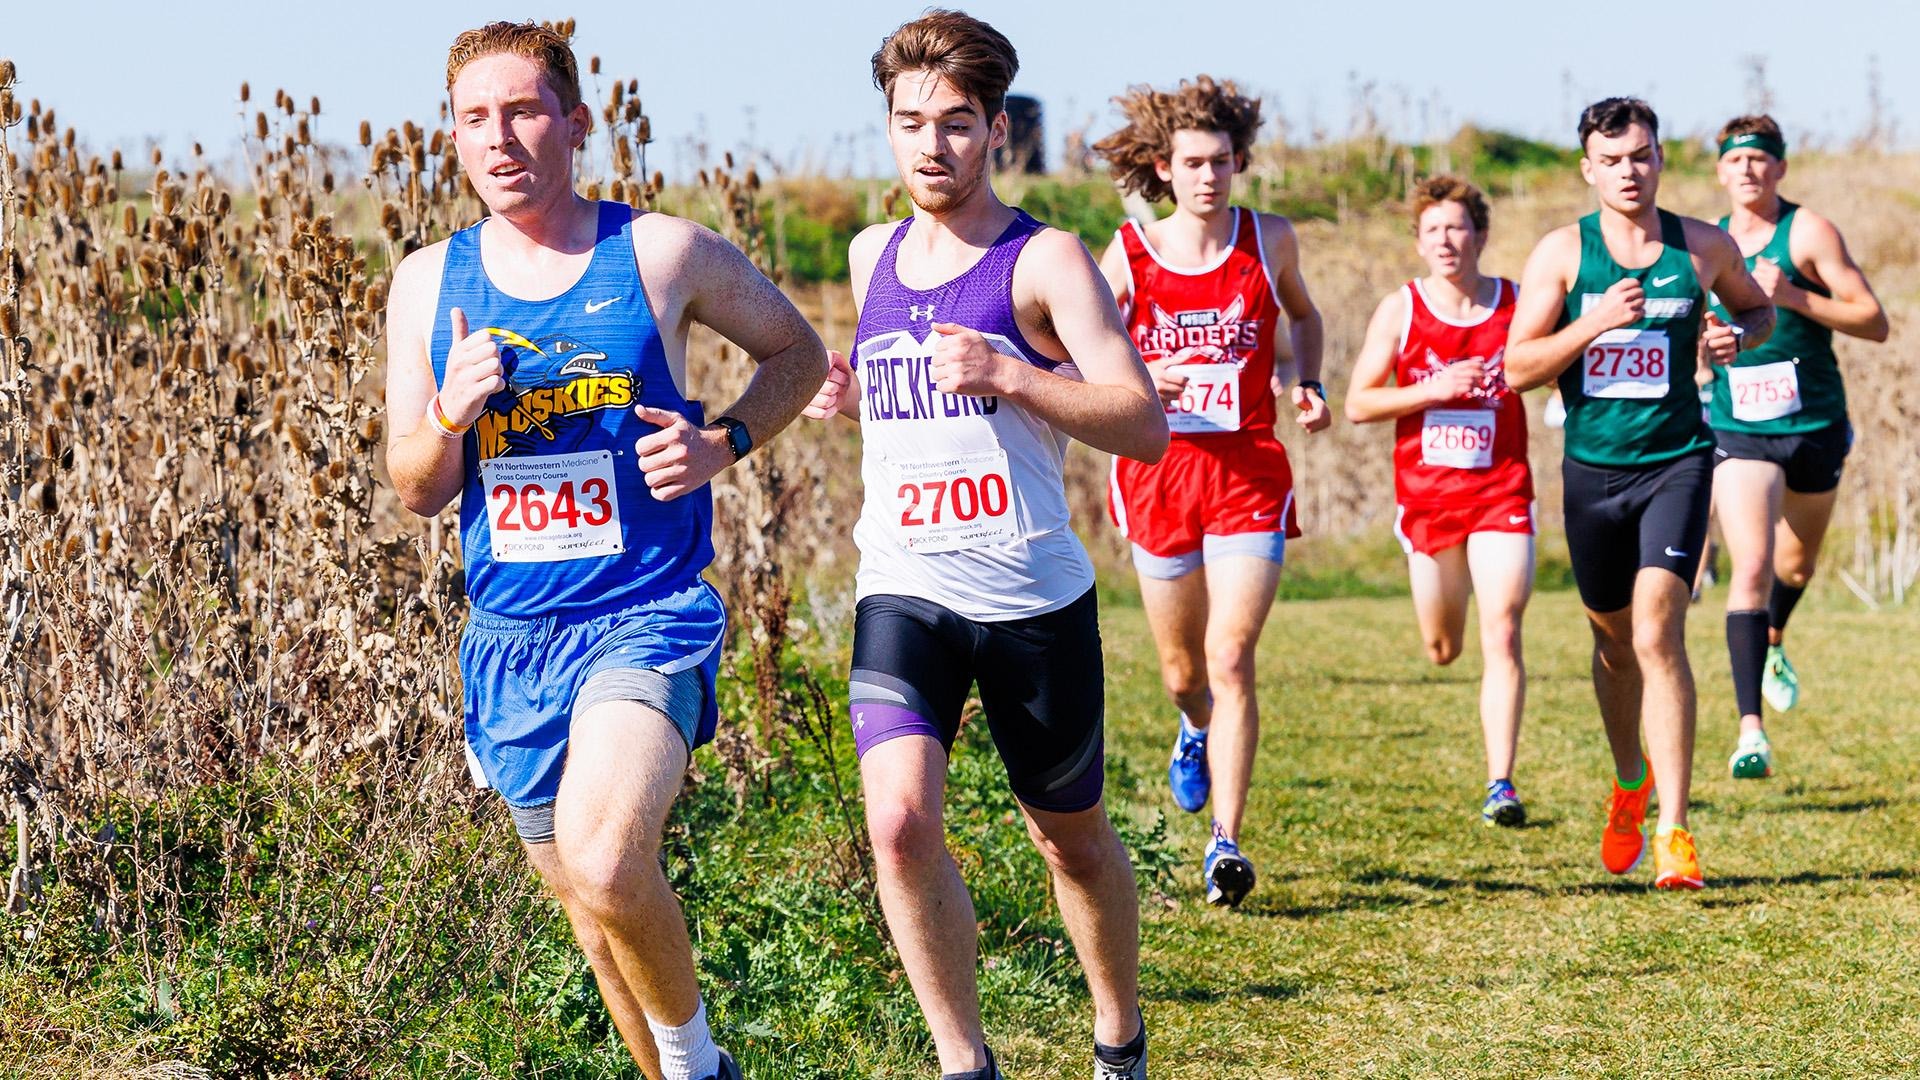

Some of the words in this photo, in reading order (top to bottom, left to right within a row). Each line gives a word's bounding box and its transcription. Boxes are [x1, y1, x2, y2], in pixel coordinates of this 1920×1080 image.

[1139, 323, 1260, 350] RAIDERS
[1588, 346, 1665, 378] 2738
[1165, 382, 1234, 414] 674
[1736, 376, 1797, 405] 2753
[476, 376, 632, 462] MUSKIES
[1428, 424, 1492, 451] 2669
[505, 461, 561, 471] Northwestern
[562, 456, 598, 468] Medicine
[515, 473, 542, 481] Country
[943, 468, 967, 477] Course
[492, 477, 613, 532] 2643
[897, 473, 1009, 527] 2700
